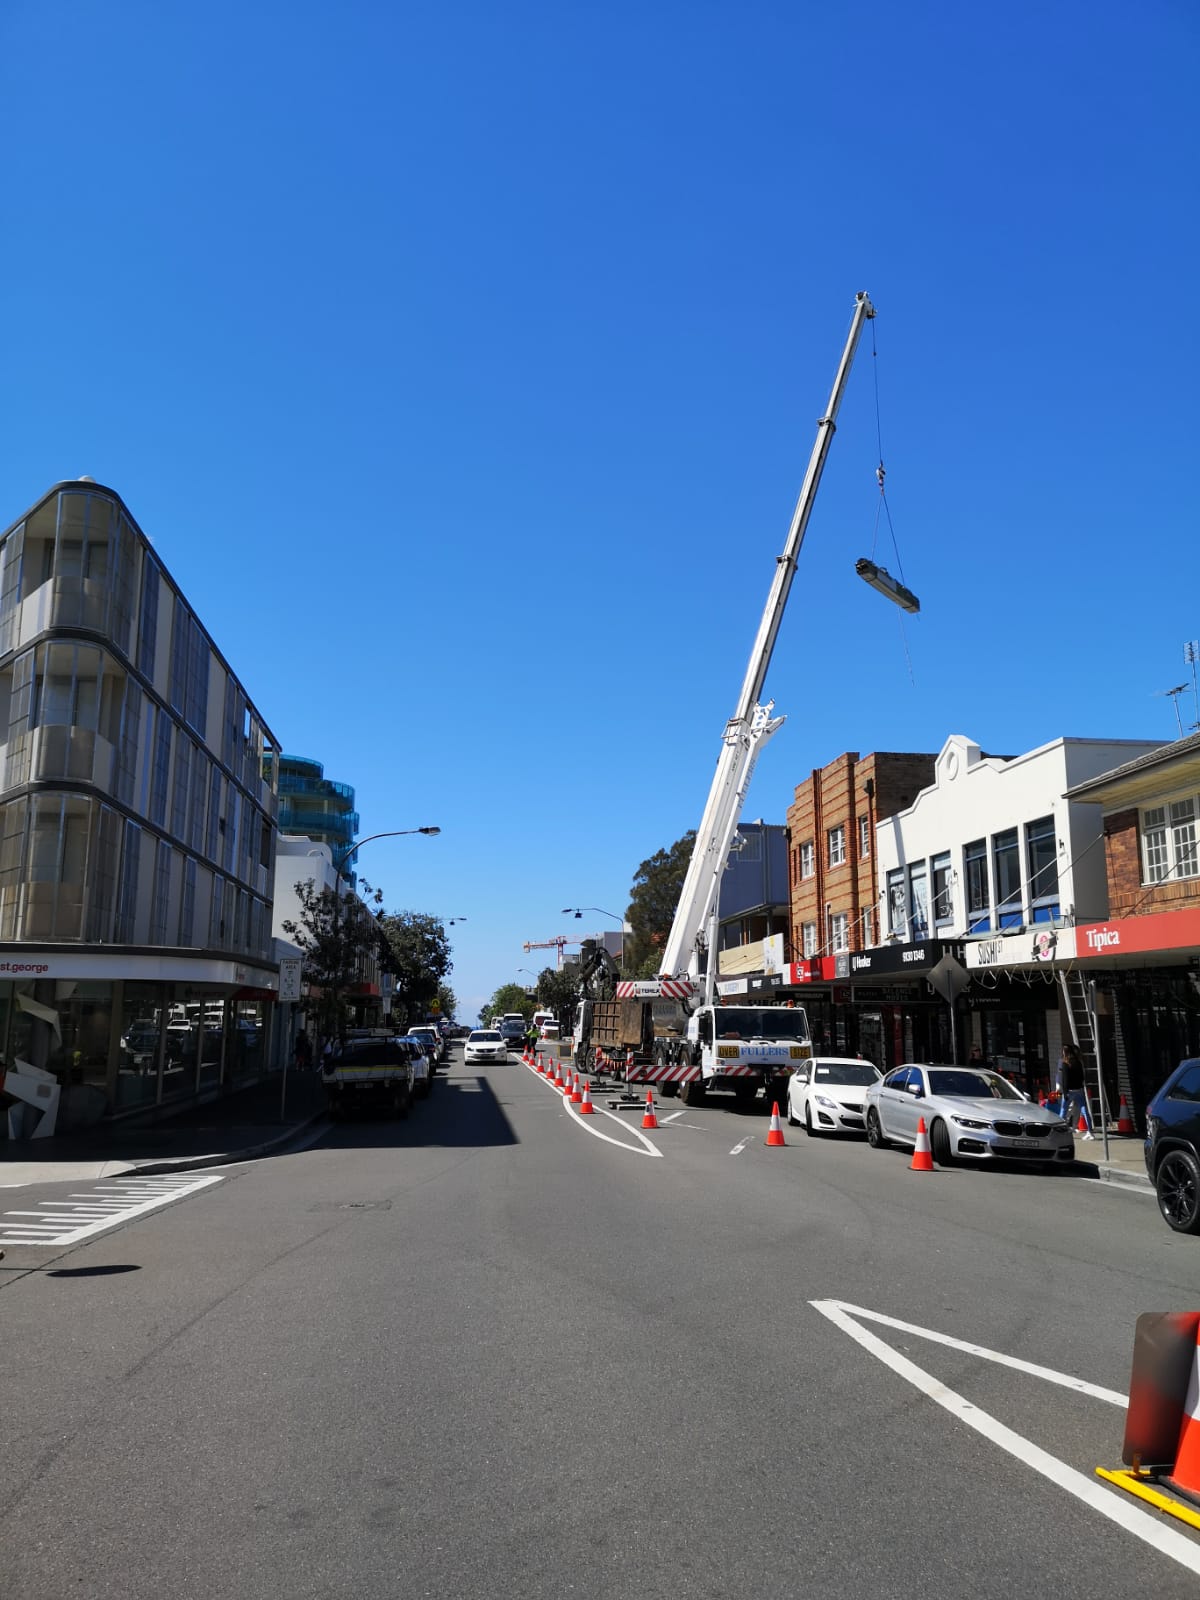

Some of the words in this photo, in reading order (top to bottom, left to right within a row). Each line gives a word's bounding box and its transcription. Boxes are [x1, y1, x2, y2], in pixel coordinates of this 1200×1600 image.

[1086, 927, 1120, 951] Tipica
[978, 940, 997, 965] SUSHI
[0, 962, 49, 973] st.george
[720, 1047, 738, 1057] OVER
[741, 1047, 789, 1056] FULLERS
